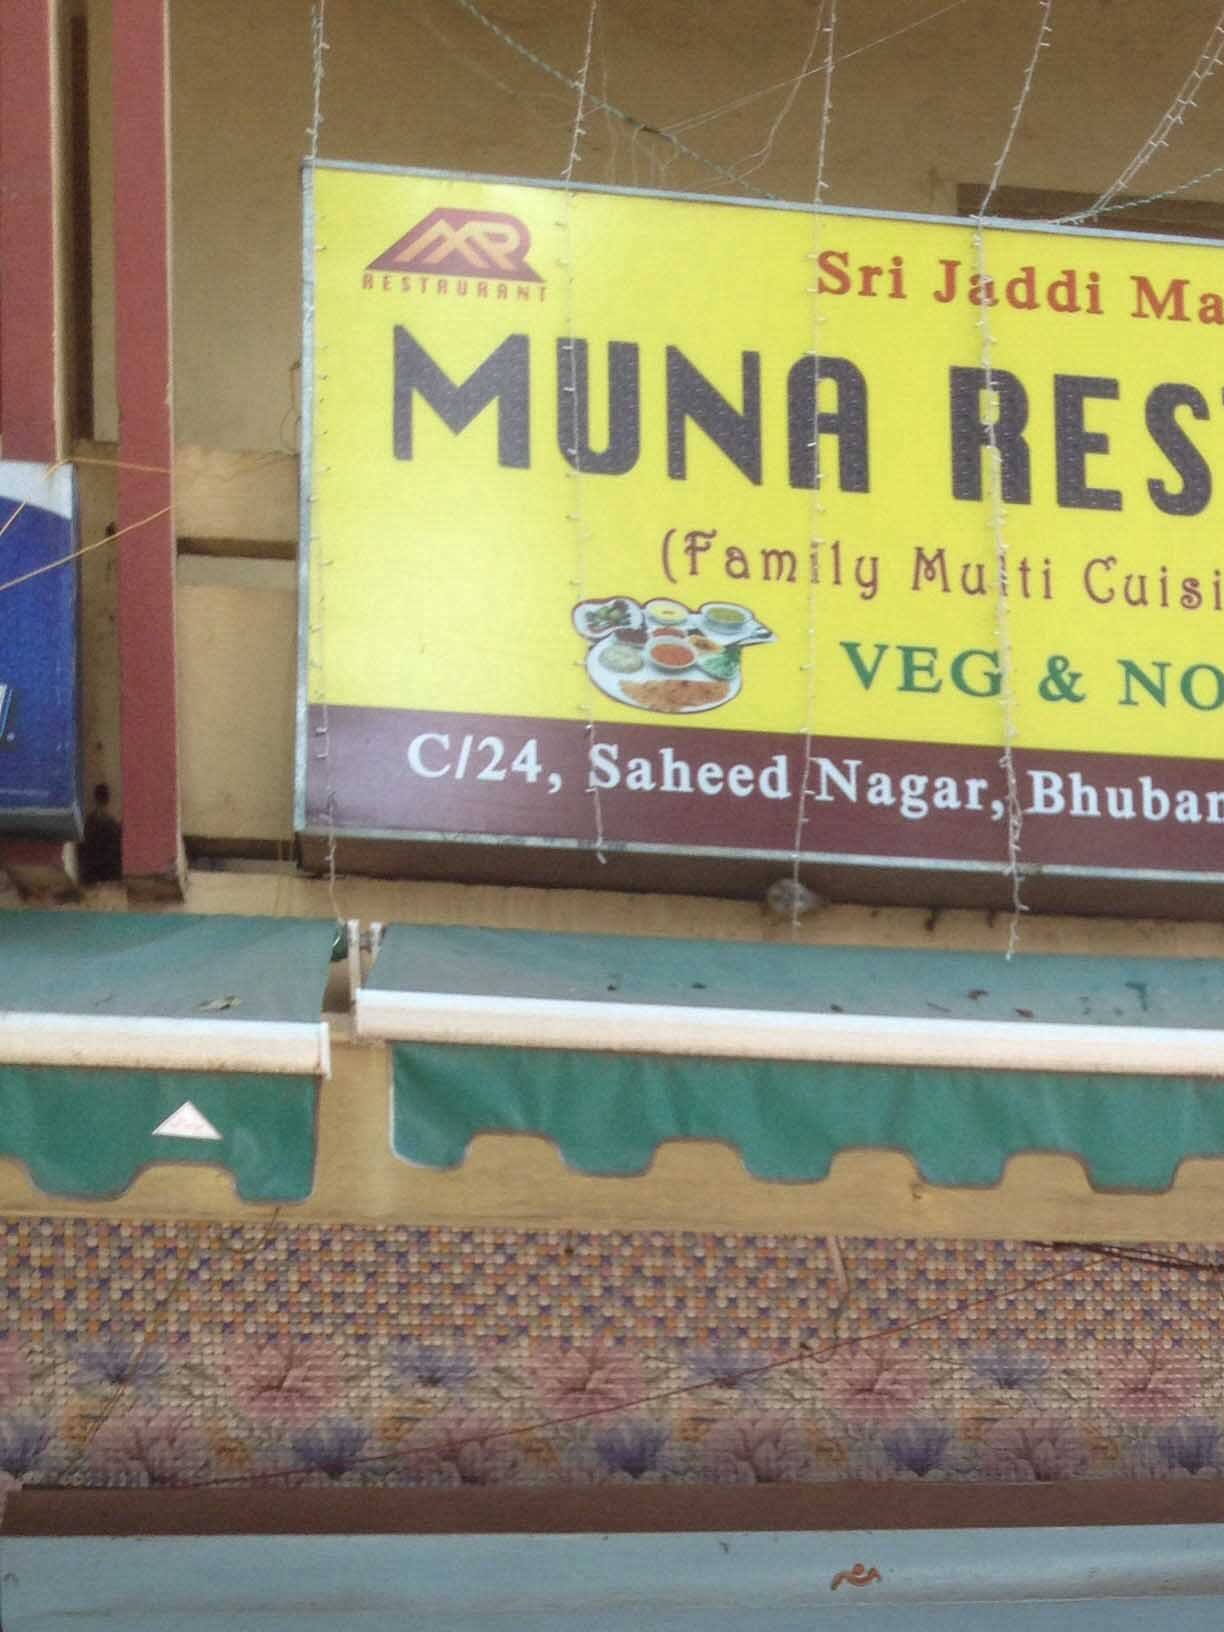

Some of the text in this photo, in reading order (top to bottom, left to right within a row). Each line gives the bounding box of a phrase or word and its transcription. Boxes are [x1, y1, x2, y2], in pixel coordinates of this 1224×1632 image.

[361, 273, 549, 302] RESTAURANT
[817, 252, 905, 299] Sri
[935, 261, 1103, 315] Jaddi
[393, 325, 871, 492] MUNA
[661, 528, 880, 601] (Family
[912, 546, 1054, 602] Multi
[840, 641, 1002, 699] VEG
[1038, 656, 1087, 703] &
[406, 731, 564, 795] C/24,
[588, 743, 792, 801] Saheed
[816, 756, 1007, 824] Nagar,
